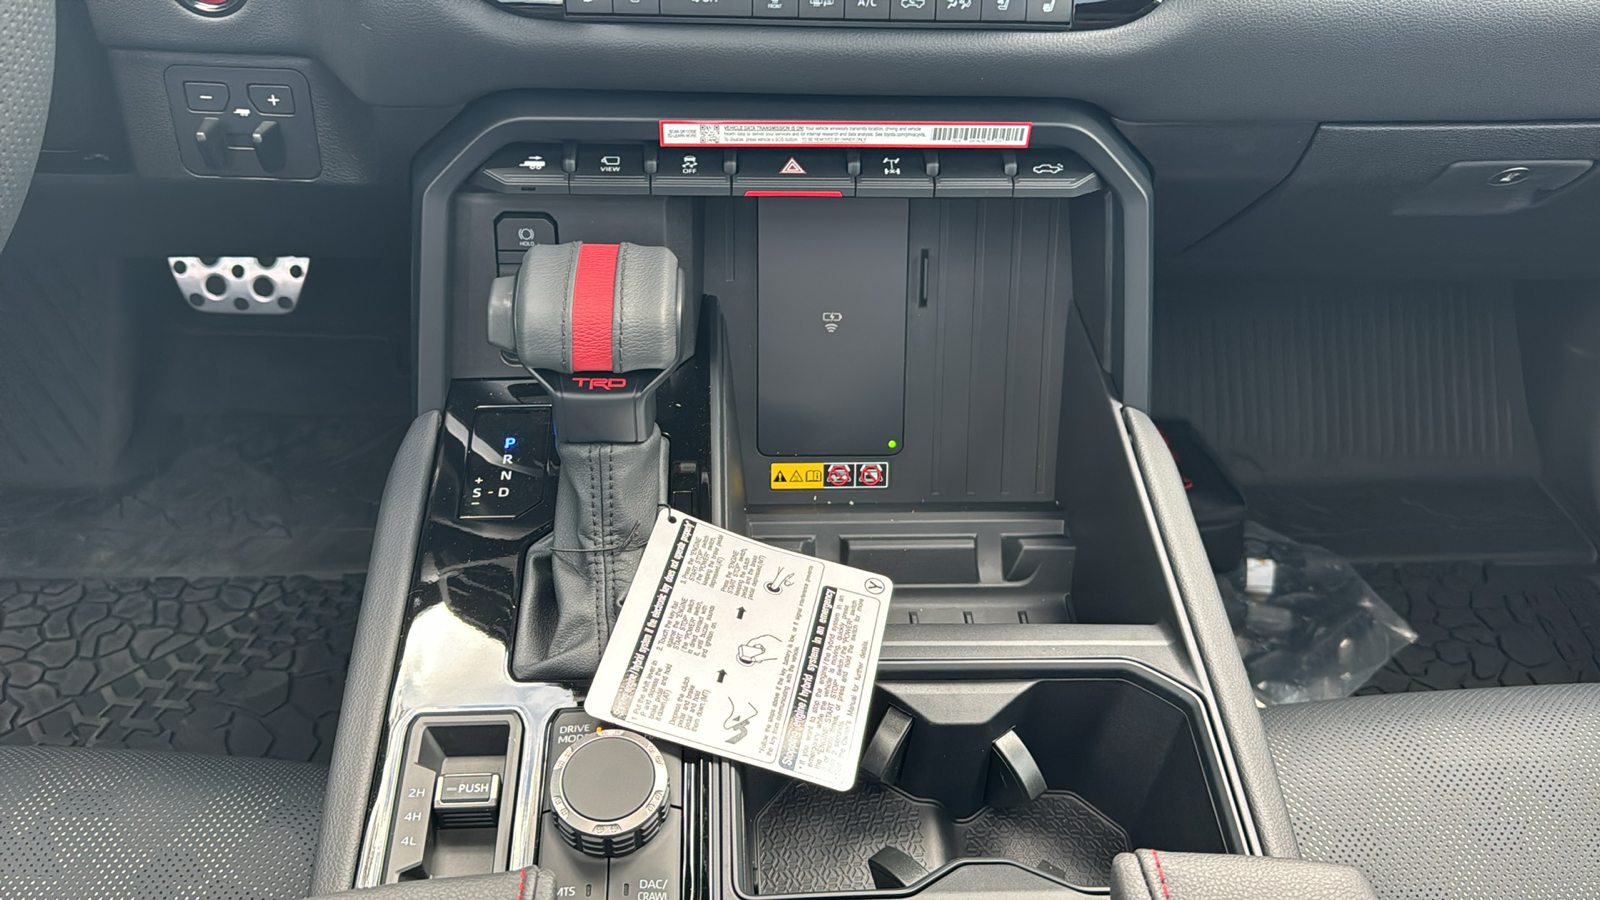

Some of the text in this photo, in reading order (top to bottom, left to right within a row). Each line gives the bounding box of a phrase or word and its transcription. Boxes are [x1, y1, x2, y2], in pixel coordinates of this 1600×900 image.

[572, 378, 626, 390] TRD
[504, 437, 516, 449] P
[502, 454, 513, 464] R
[500, 470, 512, 480] N
[472, 488, 482, 498] S
[498, 487, 510, 498] D
[867, 580, 882, 592] Y
[560, 724, 590, 734] DRIVE
[408, 788, 426, 798] 2H
[458, 782, 490, 794] PUSH
[404, 812, 422, 822] 4H
[400, 836, 417, 846] 4L
[639, 879, 668, 890] DAC/
